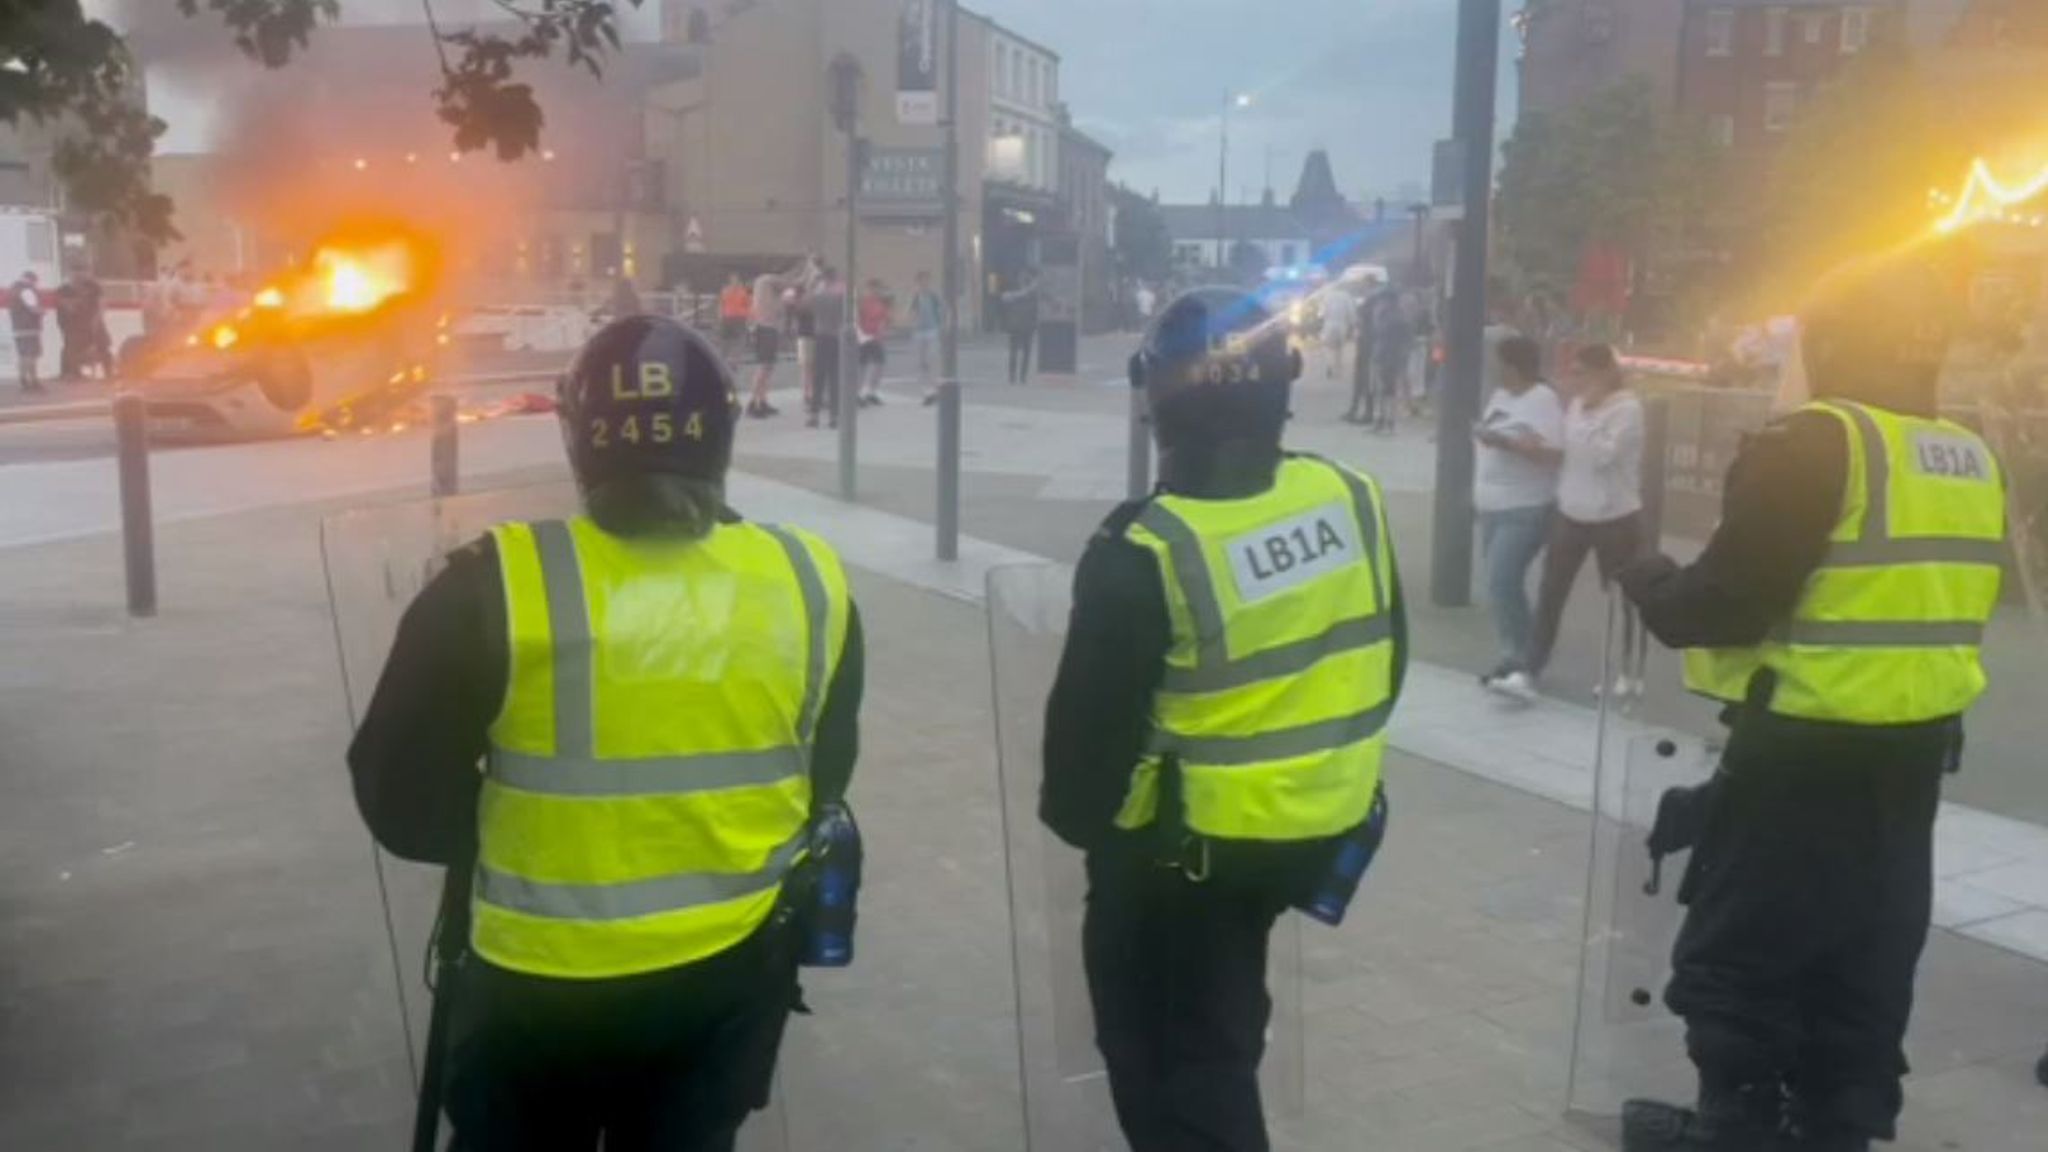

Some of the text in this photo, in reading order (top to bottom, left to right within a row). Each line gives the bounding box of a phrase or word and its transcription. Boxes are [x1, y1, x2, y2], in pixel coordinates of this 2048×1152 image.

[612, 362, 672, 399] LB
[592, 412, 703, 448] 2454
[1918, 442, 1984, 476] LB1A
[1244, 518, 1345, 580] LB1A
